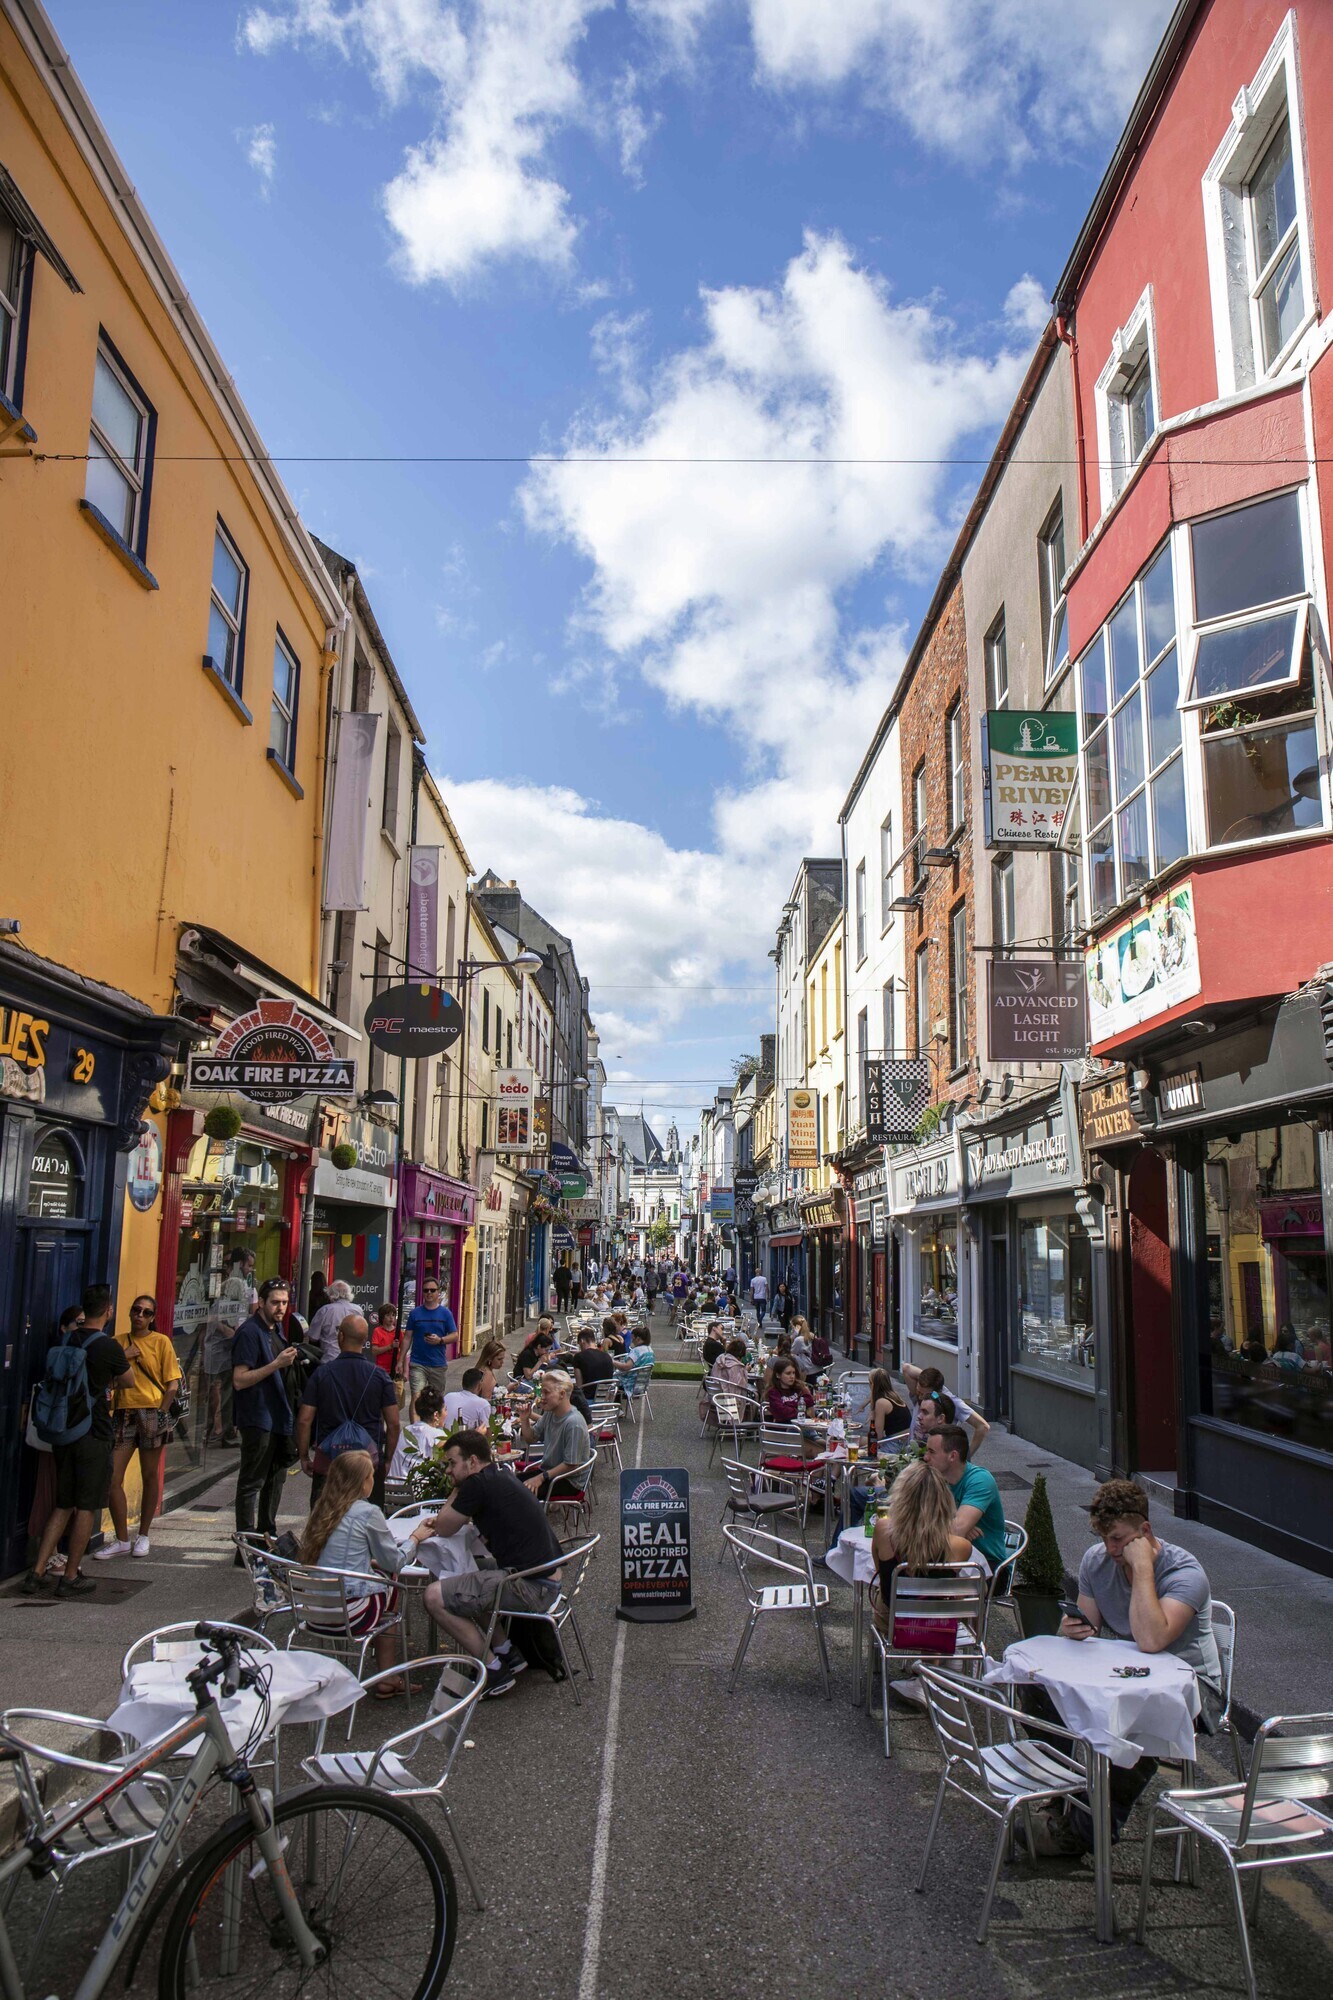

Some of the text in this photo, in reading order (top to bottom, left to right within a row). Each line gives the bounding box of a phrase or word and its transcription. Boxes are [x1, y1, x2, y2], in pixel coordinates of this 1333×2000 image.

[997, 828, 1032, 839] Chinese
[994, 996, 1079, 1008] ADVANCED
[1013, 1014, 1060, 1025] LASER
[369, 1018, 458, 1034] PC maestro
[1014, 1031, 1060, 1042] LIGHT
[240, 1031, 306, 1057] WOOD FIRED PIZZA
[1063, 1048, 1082, 1056] 1997
[73, 1048, 95, 1084] 29
[194, 1065, 350, 1085] OAK FIRE PIZZA
[500, 1082, 529, 1094] tedo
[900, 1081, 912, 1093] 19
[1159, 1069, 1201, 1113] BURNT
[275, 1090, 293, 1098] 2010
[867, 1066, 882, 1125] NASH
[292, 1110, 309, 1131] PIZZA
[1093, 1109, 1132, 1139] RIVER
[533, 1131, 547, 1147] CO
[790, 1130, 815, 1138] Ming
[872, 1134, 916, 1142] RESTAURA
[791, 1138, 815, 1146] Yuan
[983, 1133, 1068, 1173] ADVANCED LASER LIGHT
[644, 1502, 660, 1510] FIRE
[661, 1502, 685, 1510] PIZZA
[623, 1522, 687, 1546] REAL
[623, 1546, 689, 1558] WOOD FIRED
[624, 1559, 689, 1579] PIZZA
[623, 1580, 689, 1590] OPEN EVERY DAY
